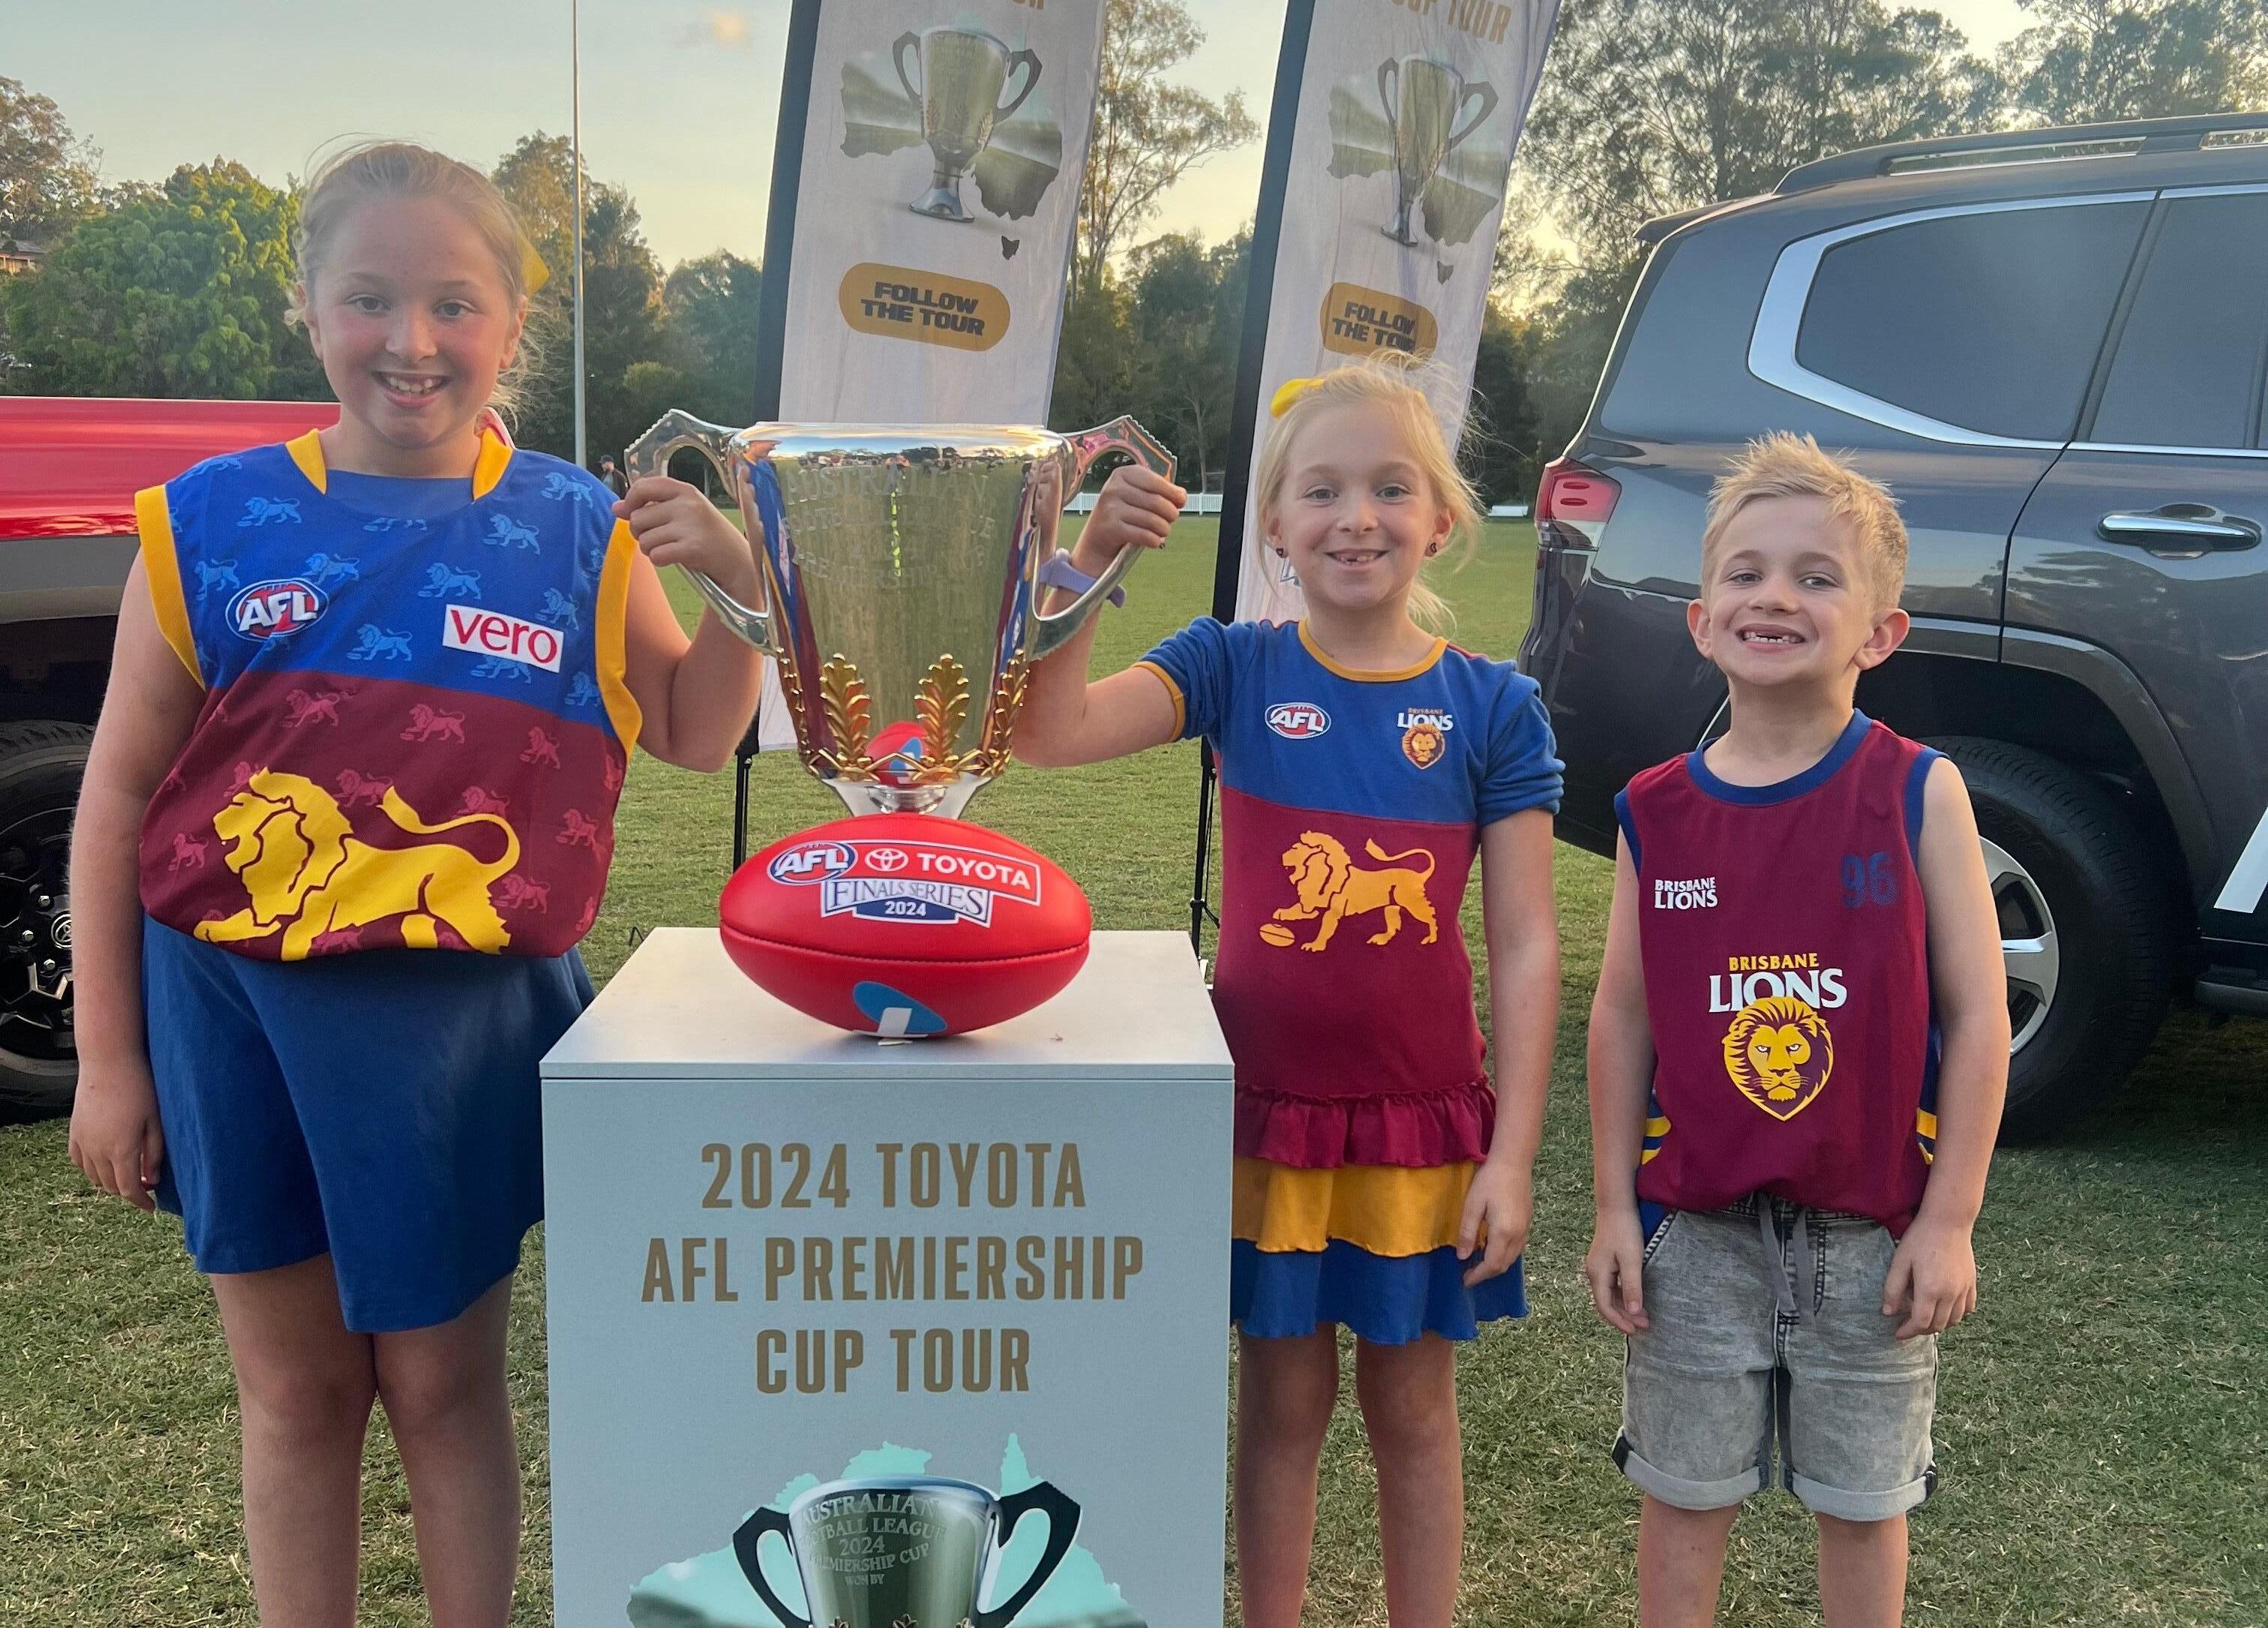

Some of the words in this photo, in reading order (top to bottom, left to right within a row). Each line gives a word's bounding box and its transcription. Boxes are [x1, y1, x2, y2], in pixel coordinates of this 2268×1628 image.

[874, 281, 979, 314] FOLLOW
[861, 299, 914, 323] THE
[920, 308, 985, 335] TOUR
[1333, 318, 1369, 342] THE
[1345, 302, 1415, 335] FOLLOW
[238, 591, 316, 632] AFL
[450, 610, 558, 663] vero
[1270, 710, 1324, 732] AFL
[1397, 713, 1454, 731] LIONS
[774, 849, 848, 876] AFL
[917, 852, 1031, 890] TOYOTA
[1654, 877, 1716, 892] BRISBANE
[1841, 852, 1897, 909] 96
[833, 878, 905, 907] FINALS
[910, 879, 984, 917] SERIES
[885, 901, 926, 916] 2024
[1654, 889, 1718, 909] LIONS
[1729, 953, 1819, 971] BRISBANE
[1708, 968, 1847, 1013] LIONS
[701, 1143, 850, 1209] 2024
[876, 1143, 1086, 1208] TOYOTA
[641, 1238, 739, 1302] AFL
[765, 1236, 1143, 1302] PREMIERSHIP
[757, 1329, 864, 1394] CUP
[890, 1329, 1030, 1392] TOUR
[803, 1493, 938, 1525] AUSTRALIAN
[838, 1535, 885, 1556] 2024
[900, 1542, 930, 1563] CUP
[870, 1574, 886, 1584] BY
